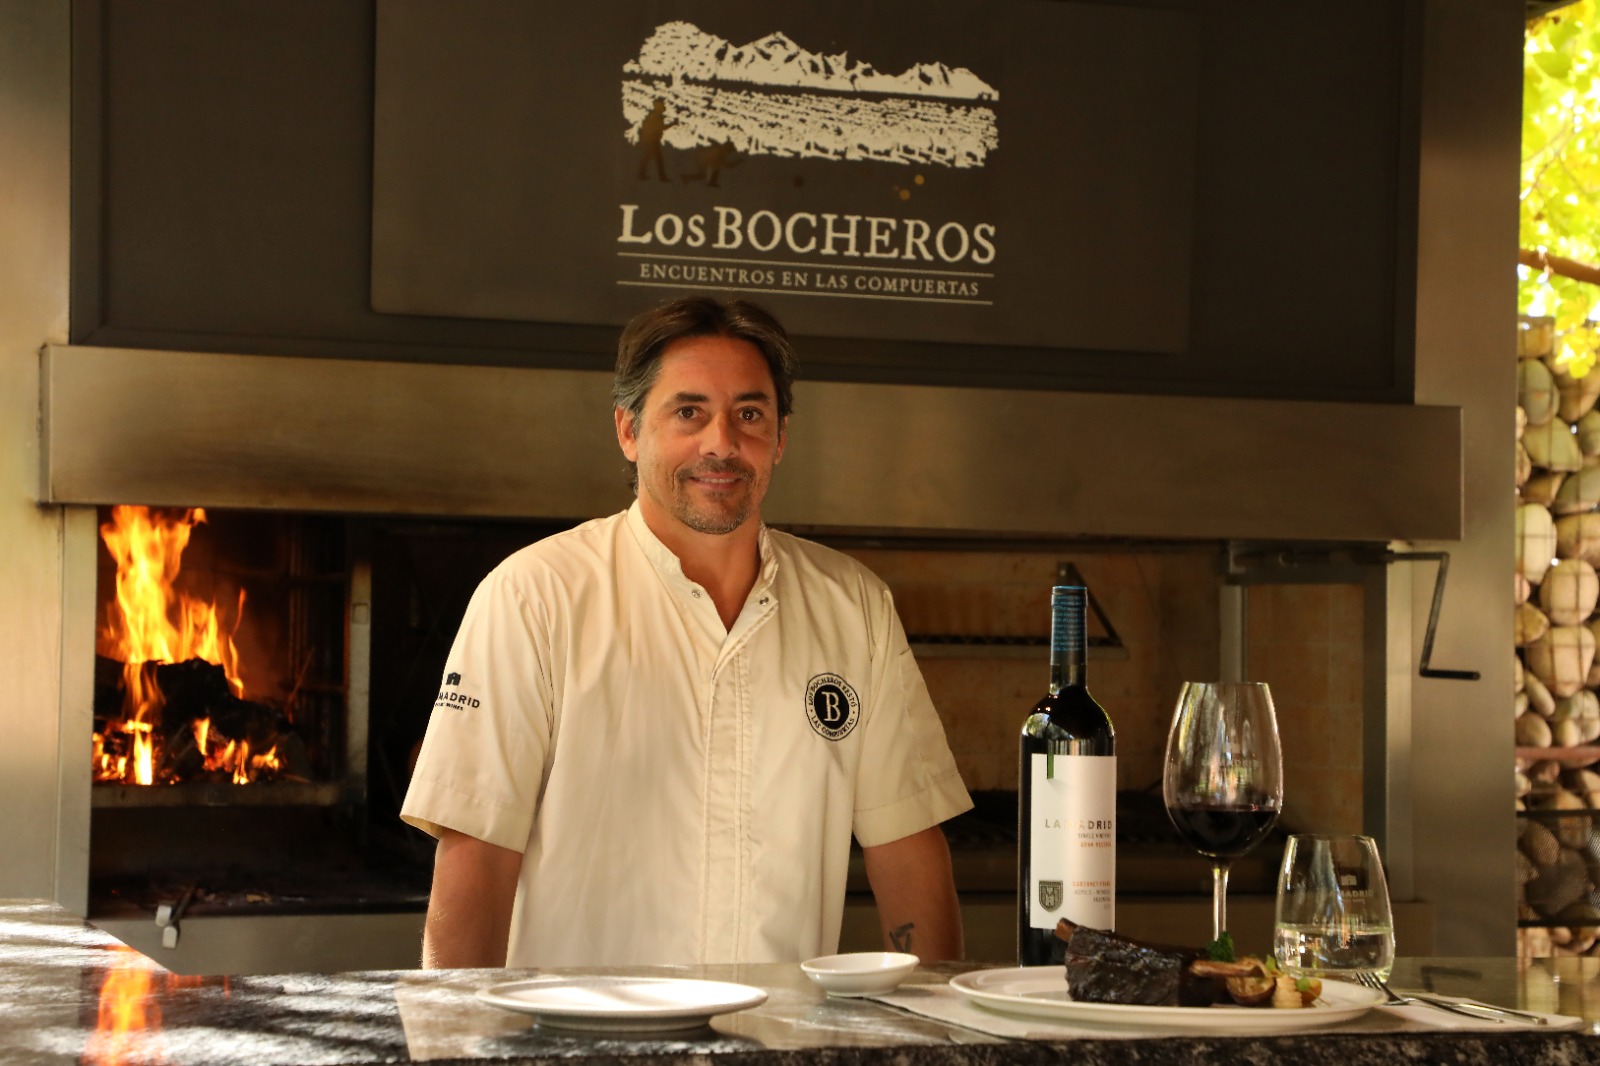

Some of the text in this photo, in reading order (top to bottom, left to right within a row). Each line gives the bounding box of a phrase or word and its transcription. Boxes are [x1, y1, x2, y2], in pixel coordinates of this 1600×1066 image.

[712, 206, 996, 264] BOCHEROS
[640, 263, 979, 297] ENCUENTROS EN LAS COMPUERTAS
[811, 715, 821, 729] LAS
[821, 691, 841, 721] B
